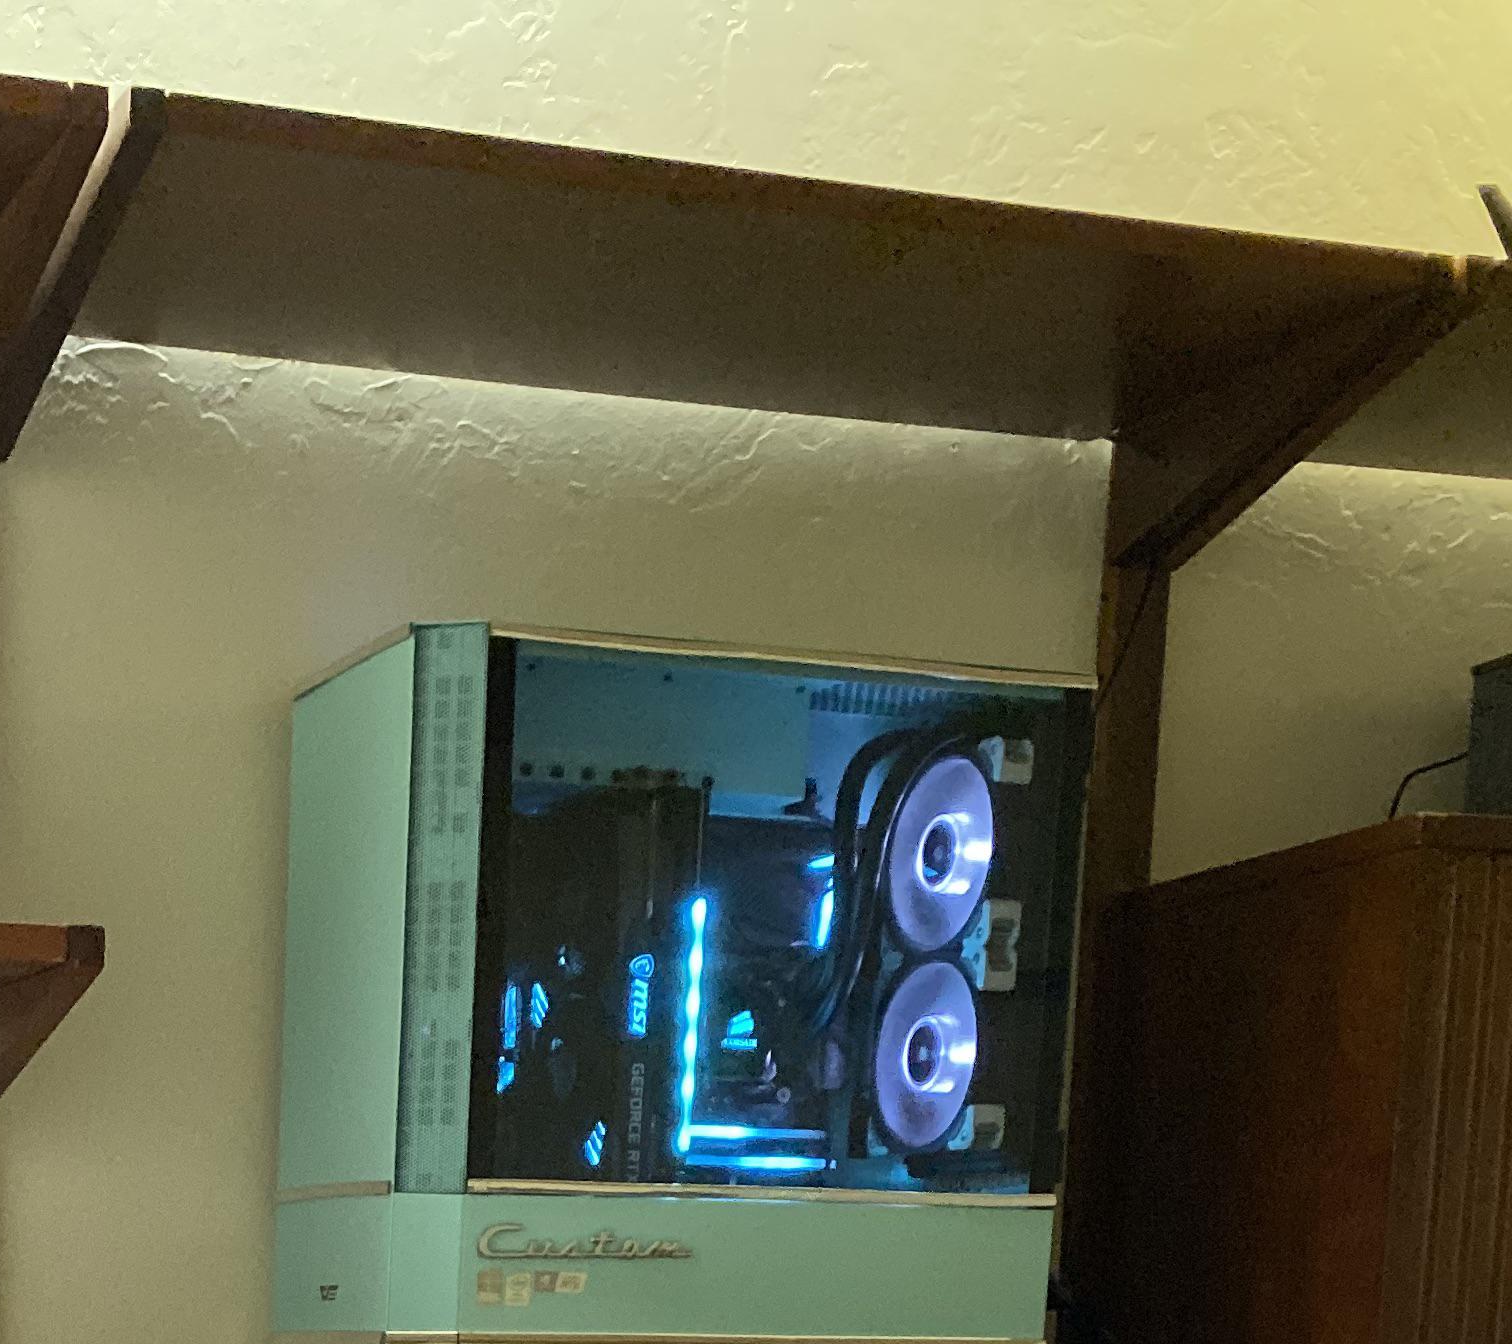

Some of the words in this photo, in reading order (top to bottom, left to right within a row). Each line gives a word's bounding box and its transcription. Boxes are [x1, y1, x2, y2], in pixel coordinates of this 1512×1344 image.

[627, 978, 650, 1035] msi
[627, 1062, 646, 1144] GEFORCE
[477, 1222, 693, 1260] Custom
